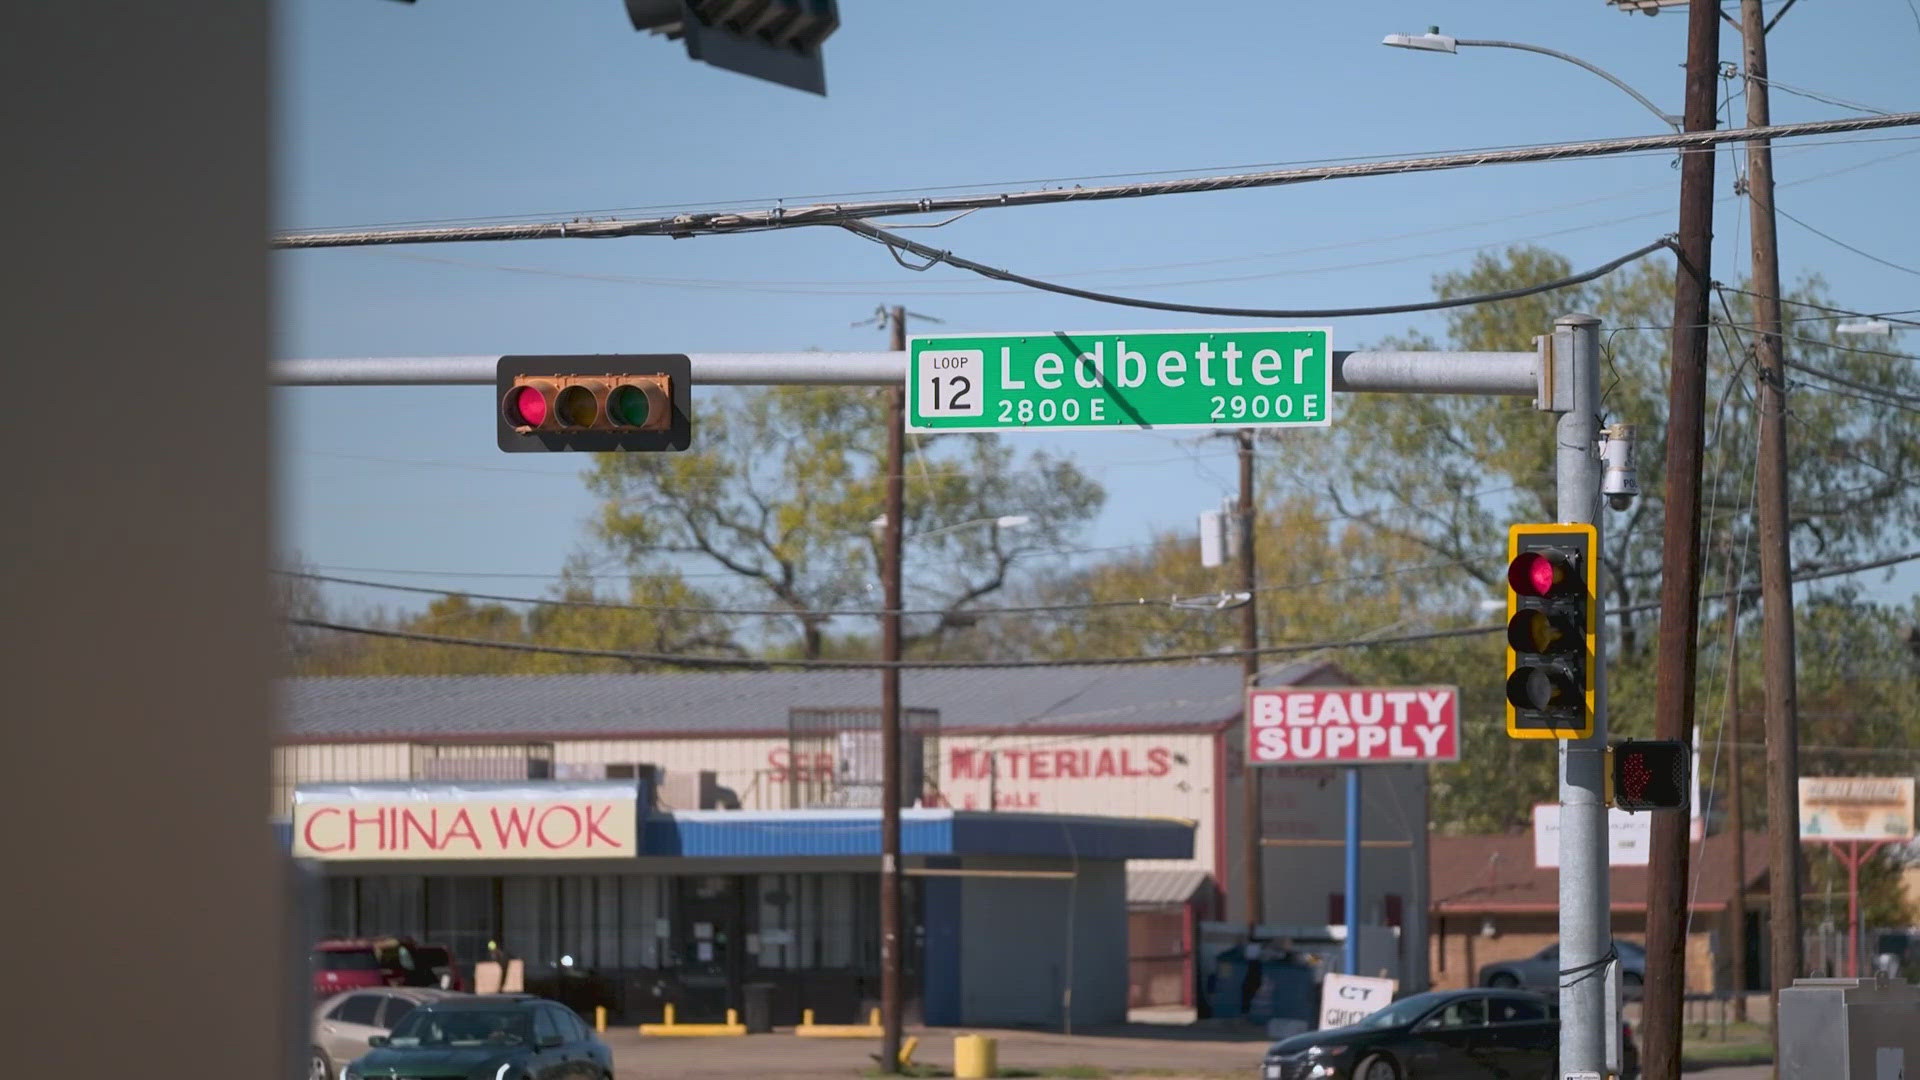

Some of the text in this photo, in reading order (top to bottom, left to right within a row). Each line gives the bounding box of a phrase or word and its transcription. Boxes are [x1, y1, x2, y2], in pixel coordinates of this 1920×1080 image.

[933, 356, 969, 370] LOOP
[1000, 340, 1314, 391] Ledbetter
[931, 375, 971, 410] 12
[1210, 393, 1319, 420] 2900 E
[997, 398, 1106, 423] 2800 E
[1252, 691, 1450, 728] BEAUTY
[1256, 724, 1448, 761] SUPPLY
[951, 746, 1171, 780] MATERIALS
[303, 804, 623, 853] CHINA WOK
